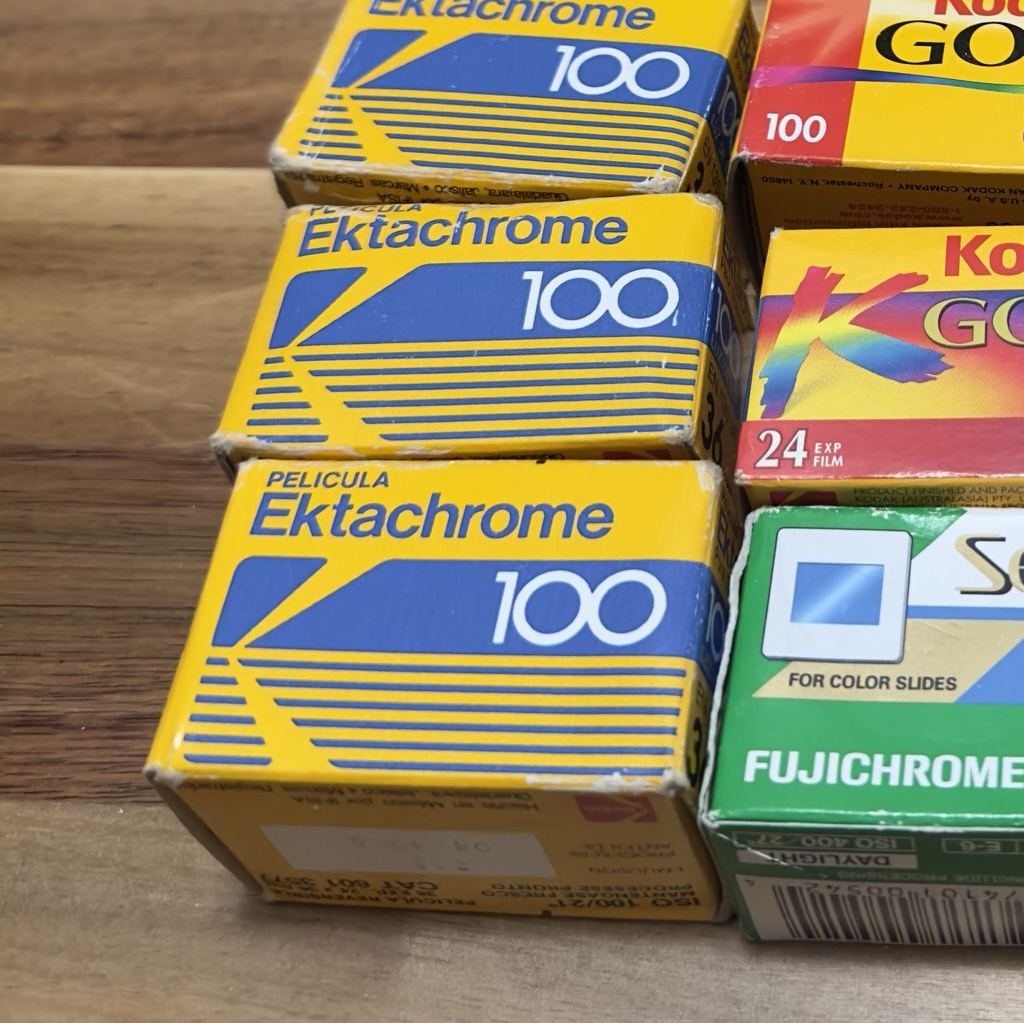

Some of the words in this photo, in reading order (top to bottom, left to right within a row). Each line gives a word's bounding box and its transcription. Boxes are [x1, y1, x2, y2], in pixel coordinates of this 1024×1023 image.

[548, 44, 692, 101] 100
[766, 112, 828, 144] 100
[897, 182, 959, 193] COMPANY
[962, 185, 1007, 195] KODAK
[966, 193, 981, 203] by
[297, 210, 629, 257] Ektachrome
[521, 268, 679, 331] 100
[754, 428, 809, 470] 24
[813, 441, 843, 454] EXP
[812, 454, 845, 468] FILM
[266, 471, 390, 489] PELICULA
[853, 486, 911, 497] PRODUCT
[913, 485, 966, 496] FINISHED
[968, 485, 998, 495] AND
[854, 496, 898, 506] KODAK
[249, 492, 615, 539] Ektachrome
[492, 569, 668, 646] 100
[788, 671, 827, 688] FOR
[829, 673, 892, 691] COLOR
[895, 675, 957, 692] SLIDES
[854, 835, 897, 850] ISO
[959, 839, 1001, 853] E-6
[767, 851, 891, 867] DAYLIGHT
[383, 880, 440, 891] CAT
[650, 897, 701, 908] ISO
